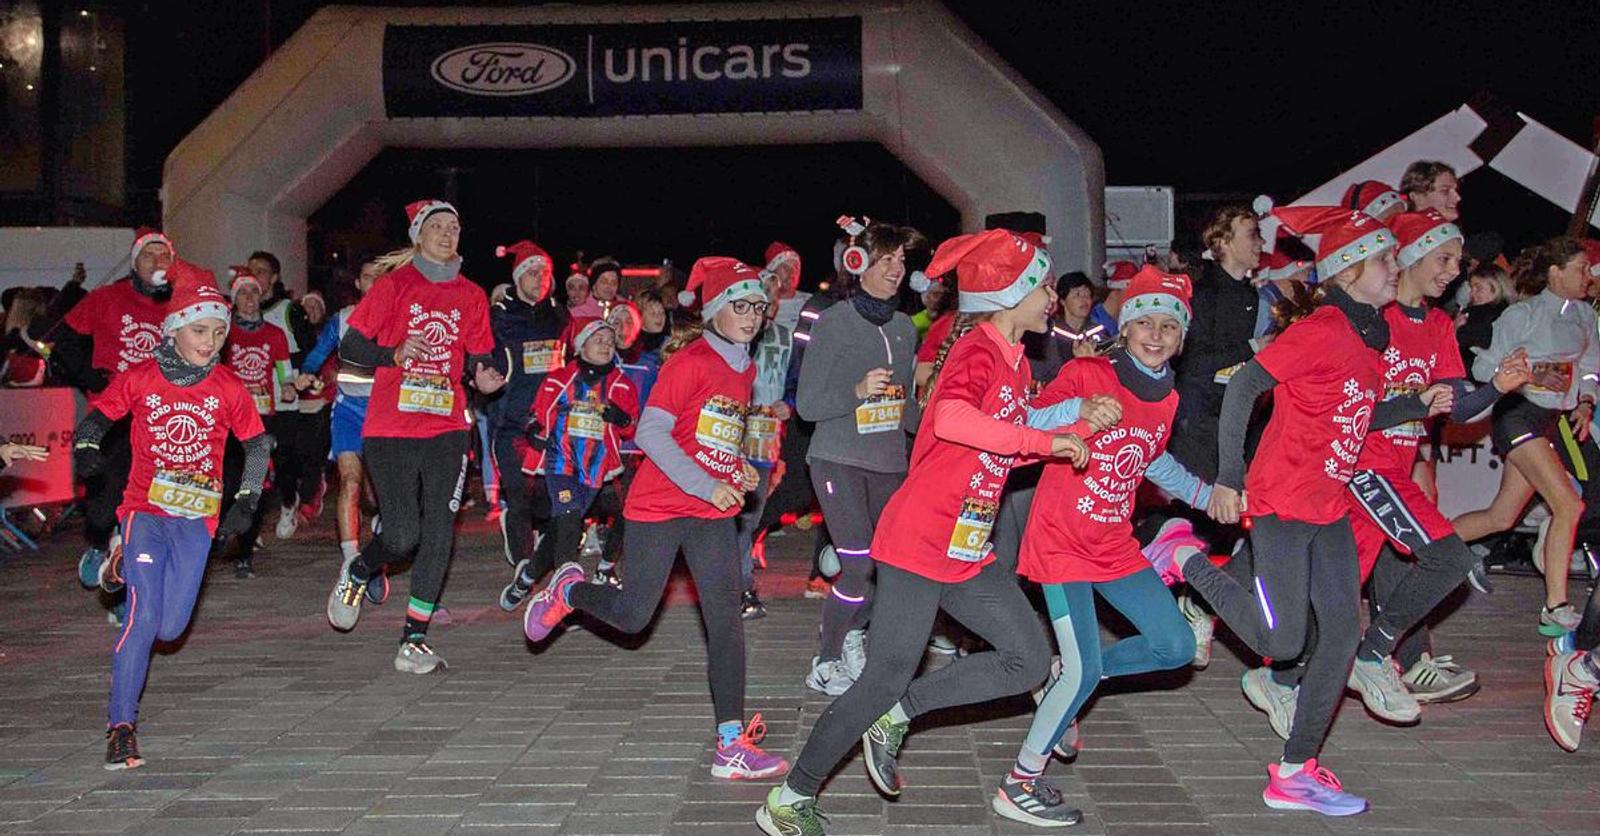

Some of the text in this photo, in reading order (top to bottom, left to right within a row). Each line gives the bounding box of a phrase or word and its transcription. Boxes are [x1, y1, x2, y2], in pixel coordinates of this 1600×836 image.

[459, 49, 547, 85] Ford
[604, 36, 813, 84] unicars
[1385, 360, 1407, 380] FORD
[1338, 392, 1363, 413] FORD
[147, 402, 215, 426] FORD UNICARS
[155, 432, 166, 440] 20
[712, 422, 741, 441] 669
[1095, 428, 1127, 450] FORD
[160, 441, 203, 455] AVANTI
[1092, 452, 1114, 461] KERST
[1099, 462, 1112, 472] 20
[163, 490, 205, 509] 6726
[967, 531, 988, 549] 67
